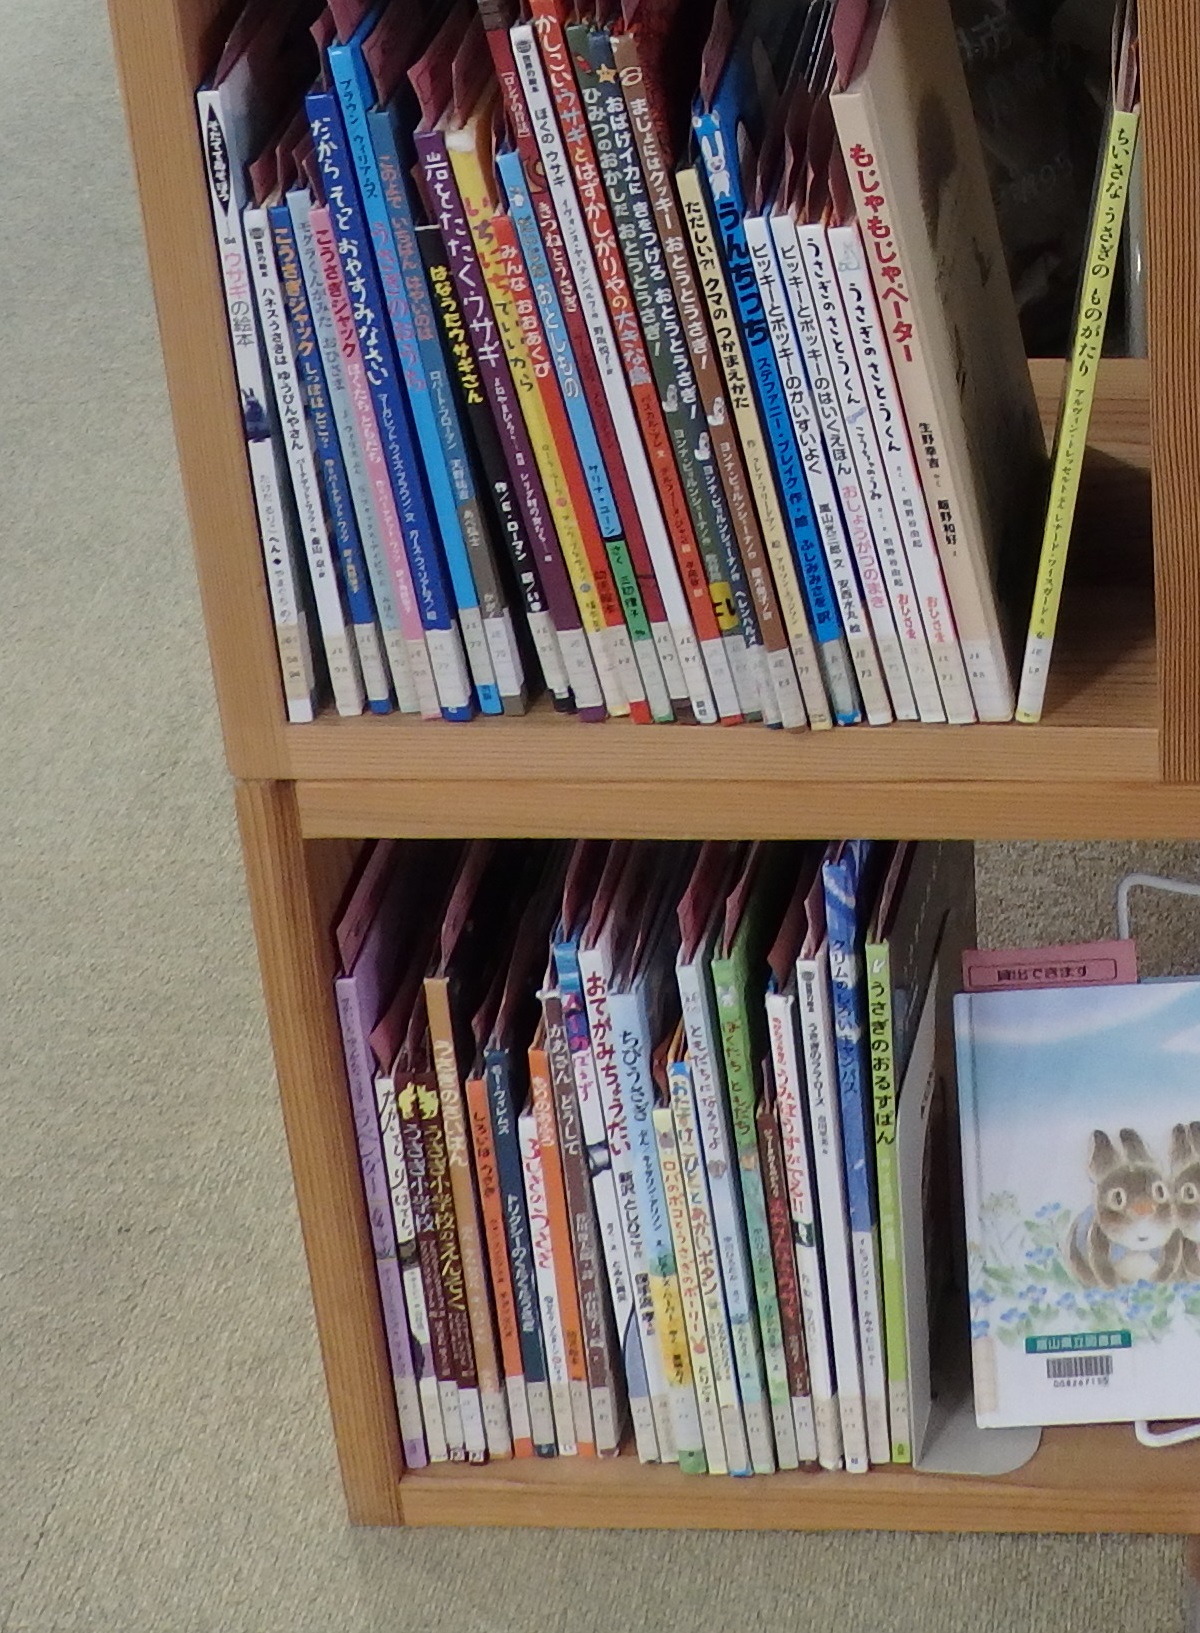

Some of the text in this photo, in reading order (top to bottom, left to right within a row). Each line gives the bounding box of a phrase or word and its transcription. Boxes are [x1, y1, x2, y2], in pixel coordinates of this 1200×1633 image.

[309, 117, 341, 181] たから
[338, 77, 361, 128] ブラウン
[534, 108, 565, 188] ぼくの ウサギ
[329, 185, 351, 232] そっと
[538, 201, 578, 315] きつねとうさぎ
[605, 97, 643, 196] おばけイカに
[632, 201, 665, 281] きをつけろ
[654, 287, 698, 420] おとうとうさぎ!
[630, 98, 675, 231] まじょにはクッキー
[665, 236, 709, 371] おとうとうさぎ!
[717, 201, 769, 348] うんちっち
[849, 144, 915, 363] もじゃもじゃペーター
[1077, 126, 1131, 379] ちいさな うさぎの ものがたり
[274, 227, 314, 355] こうさぎジャック
[314, 228, 357, 358] こうさぎジャック
[337, 237, 384, 387] おやすみなさい
[430, 265, 484, 405] はなうたウサギさん
[500, 243, 527, 293] みんな
[515, 298, 549, 379] おおあくび
[618, 222, 663, 358] おとうとうさぎ!
[704, 276, 731, 321] クマの
[804, 237, 862, 405] うさぎのさとうくん
[276, 369, 305, 451] ゆうびんやさん
[716, 325, 750, 409] つかまえかた
[848, 282, 902, 453] うさぎのさとうくん
[842, 484, 886, 610] おしょうがつのまき
[586, 971, 631, 1157] おてがみちょうだい
[870, 980, 897, 1146] うさぎのおるすばん
